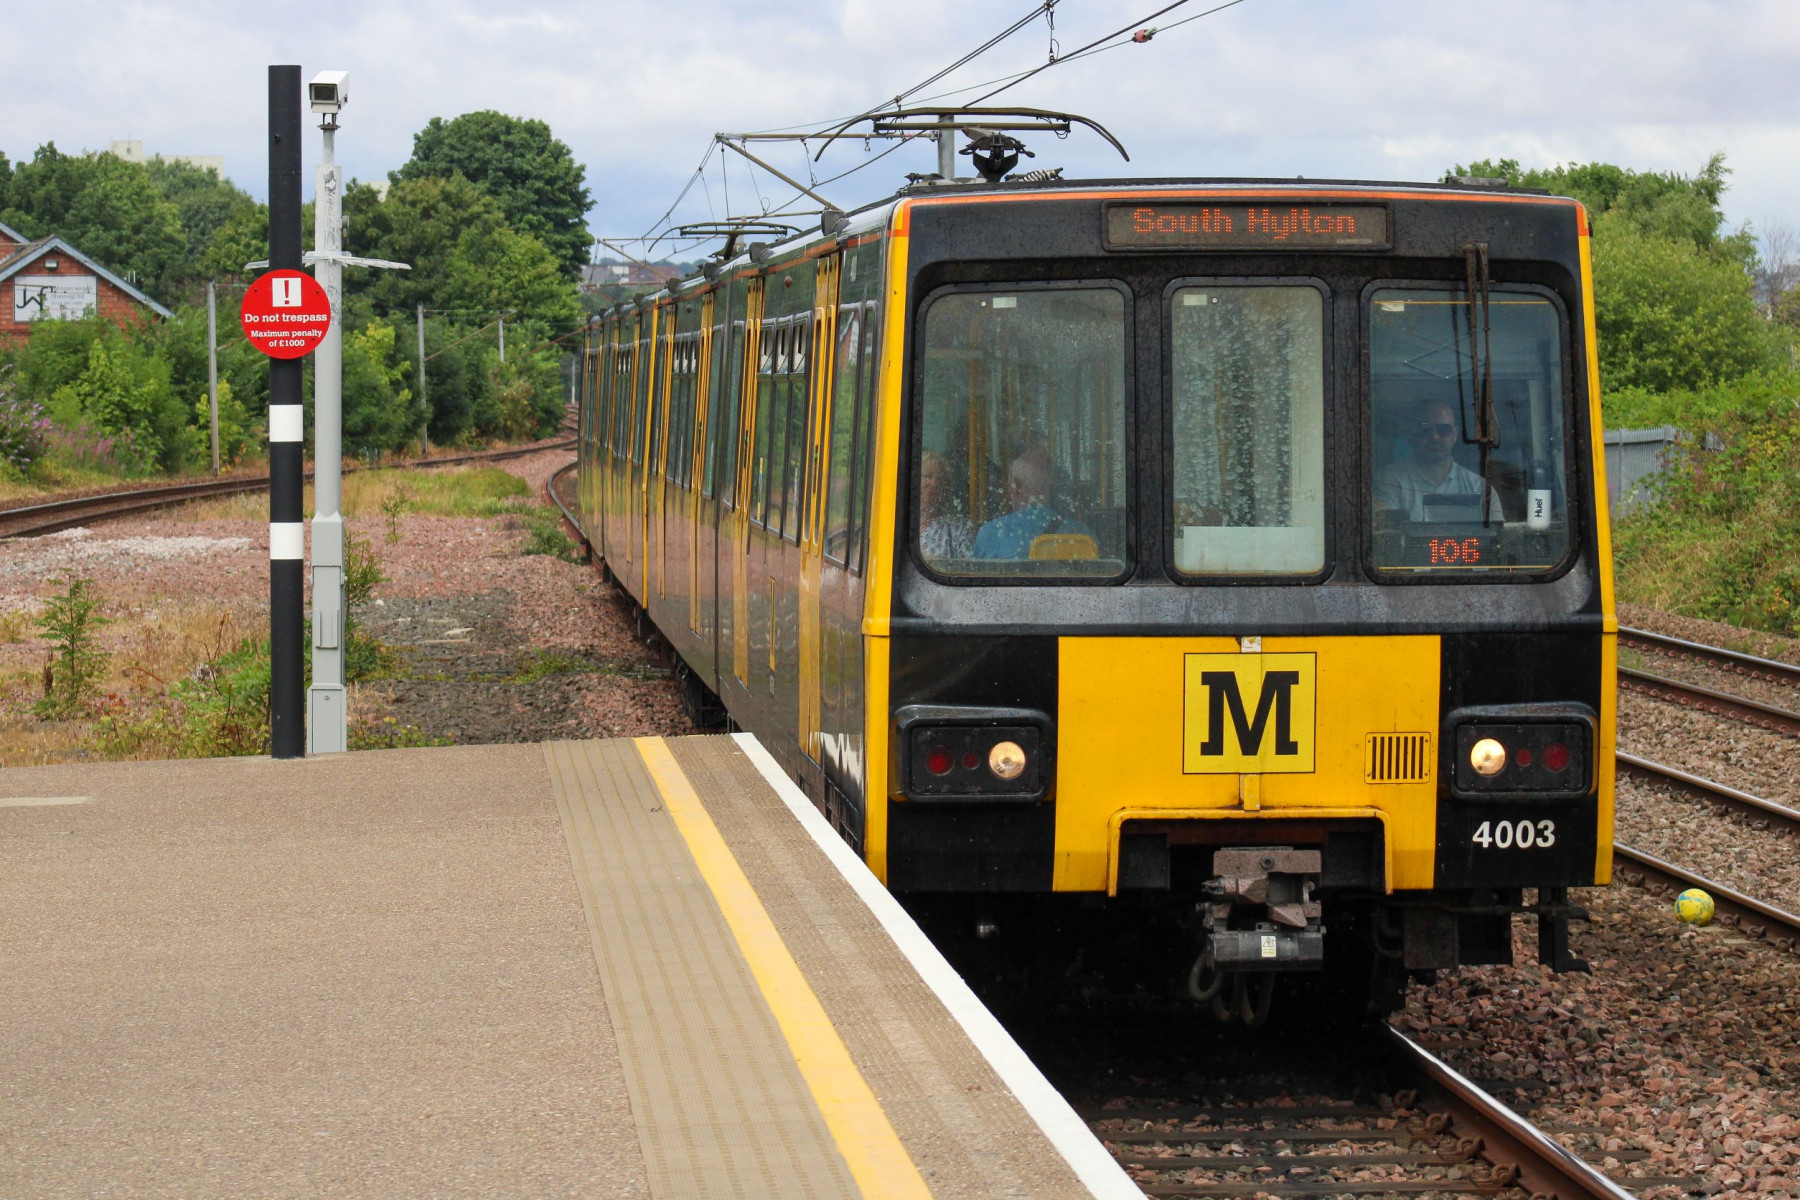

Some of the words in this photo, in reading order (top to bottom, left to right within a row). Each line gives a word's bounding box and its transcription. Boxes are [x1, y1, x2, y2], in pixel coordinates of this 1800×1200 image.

[1133, 208, 1232, 233] South
[1248, 208, 1355, 240] Hylton
[244, 313, 260, 323] Do
[262, 313, 280, 323] not
[282, 312, 328, 324] trespass
[250, 329, 290, 338] Maximum
[291, 329, 323, 338] penalty
[268, 339, 278, 347] of
[279, 339, 306, 347] £1000
[1534, 497, 1543, 518] Huel
[1428, 537, 1480, 564] 106
[1200, 670, 1300, 757] M
[1472, 819, 1556, 849] 4003
